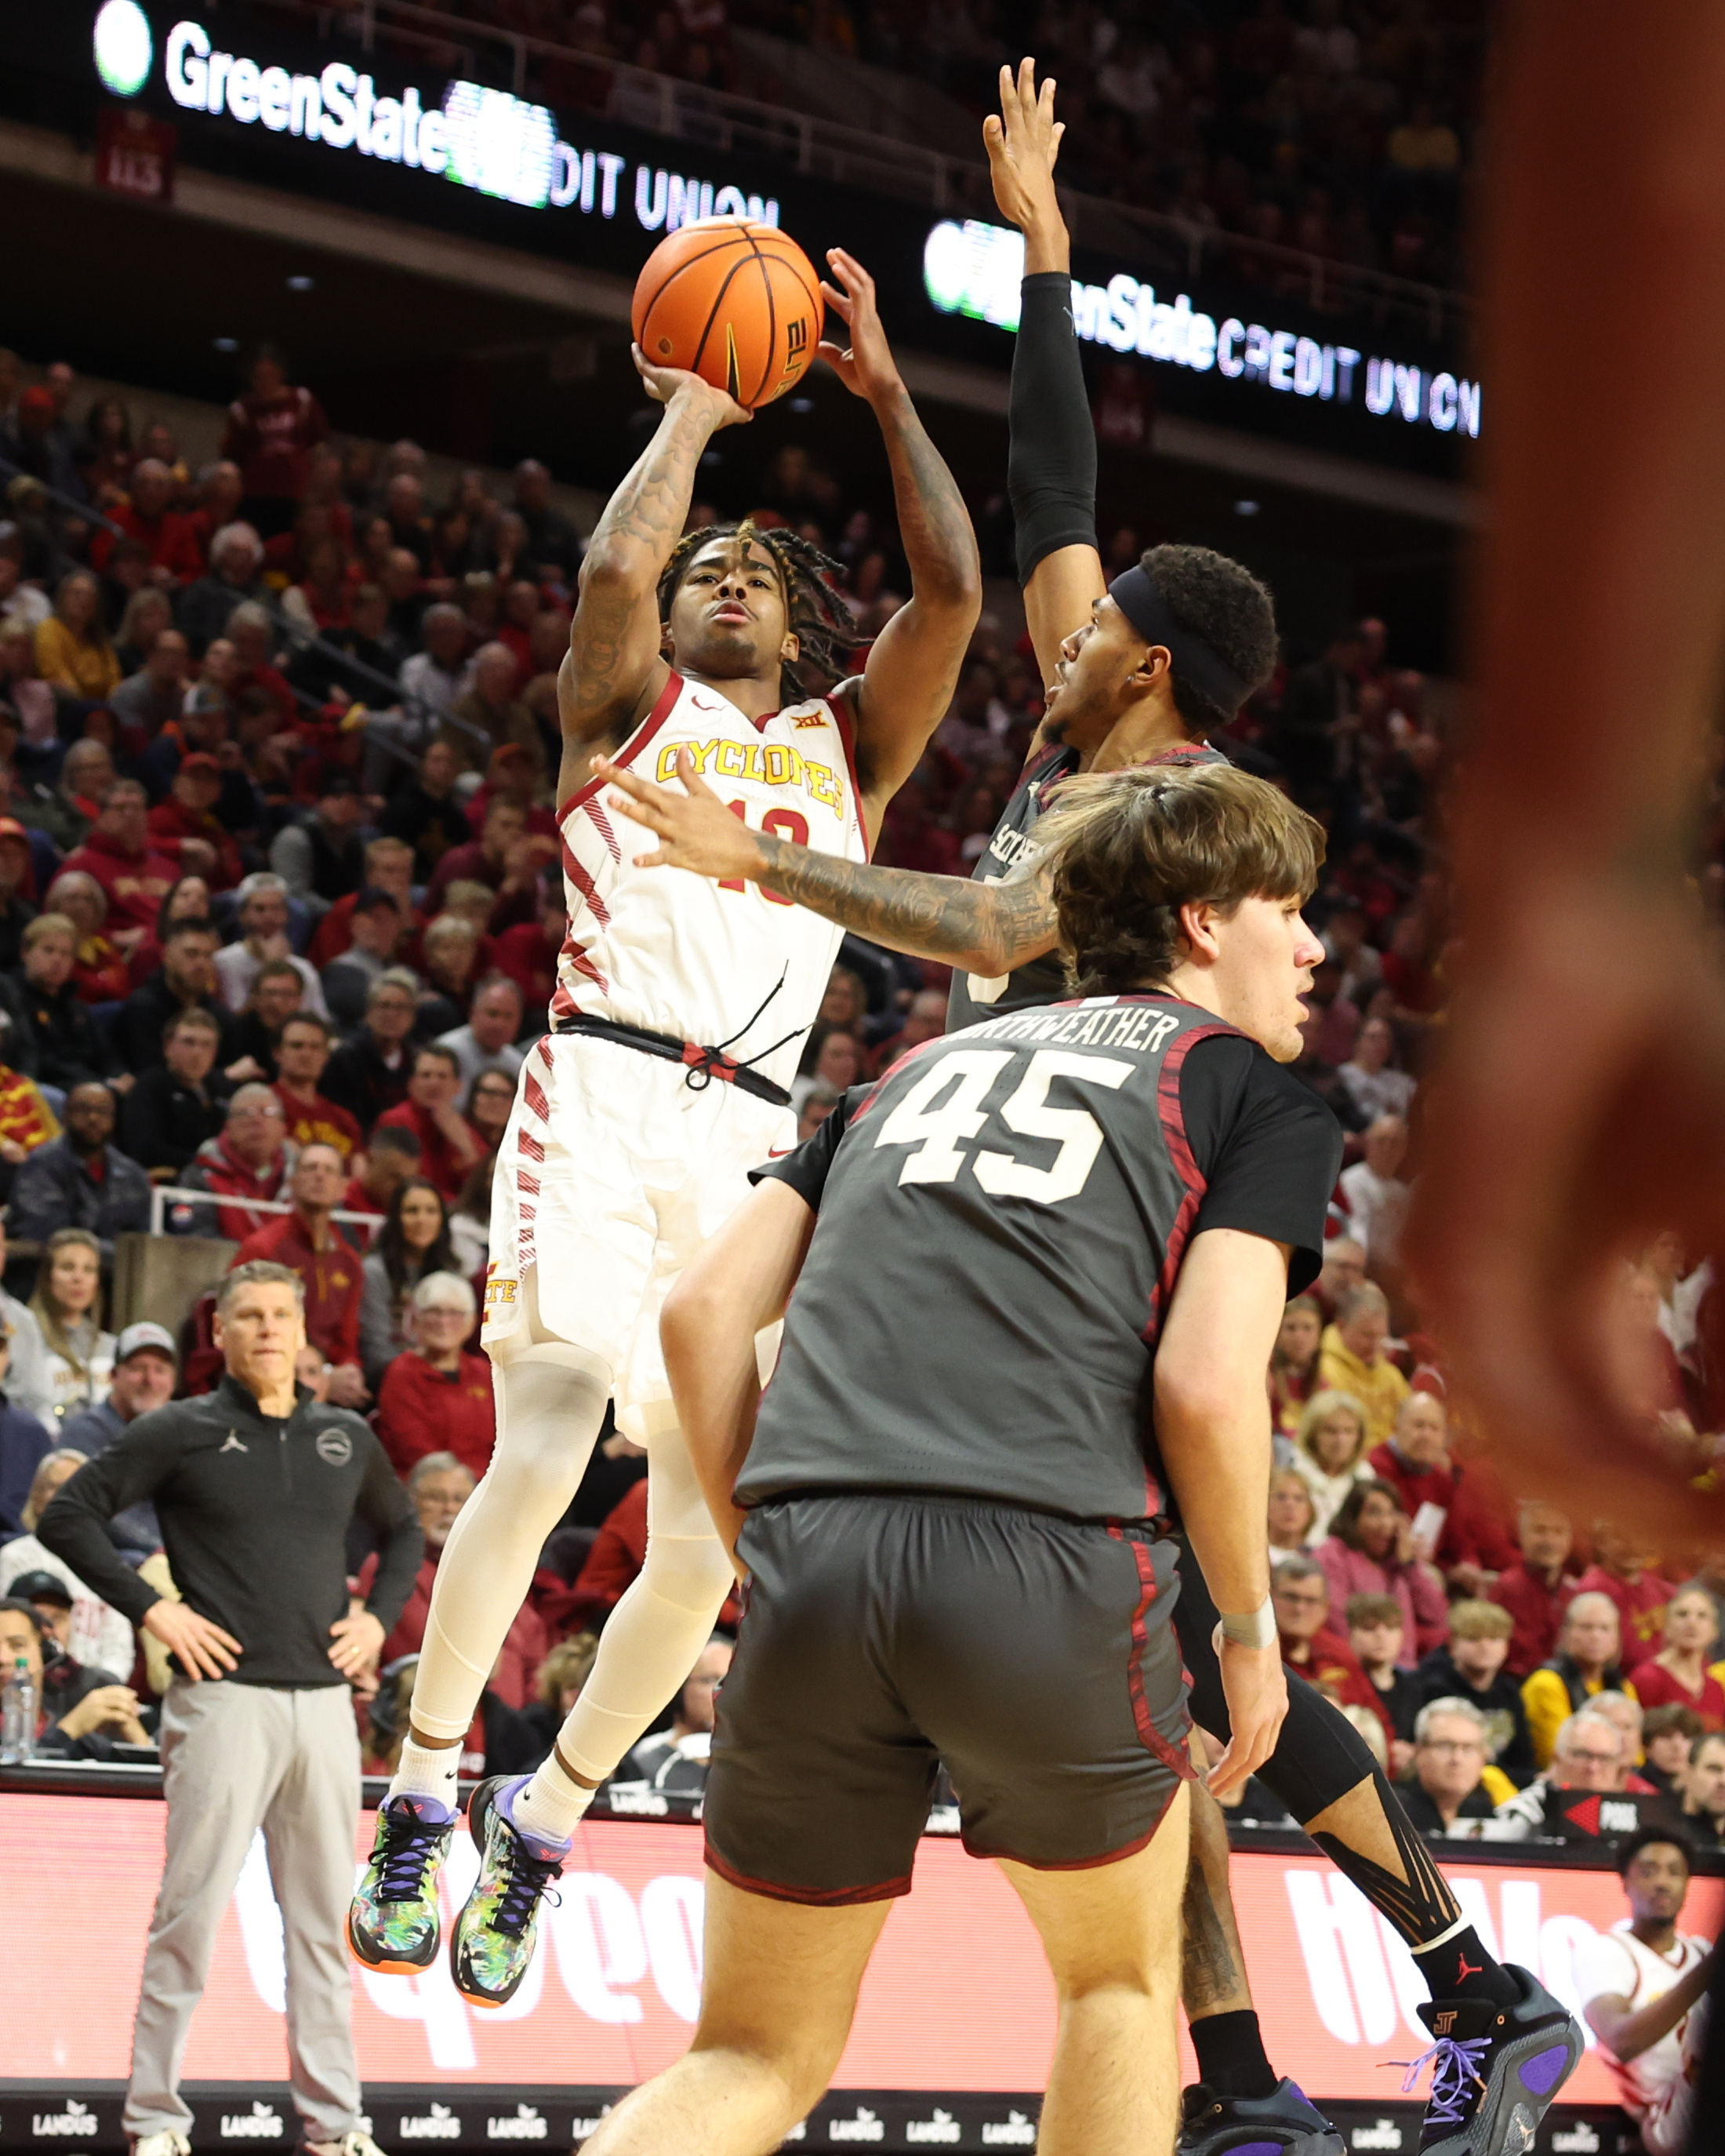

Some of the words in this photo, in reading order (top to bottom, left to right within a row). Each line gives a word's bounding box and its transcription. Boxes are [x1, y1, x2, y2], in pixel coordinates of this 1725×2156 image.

[165, 20, 452, 174] GreenState
[1217, 318, 1361, 405] CREDIT
[656, 738, 844, 821] CYCLONES
[873, 1049, 1137, 1205] 45
[32, 2114, 99, 2136] LANDUS
